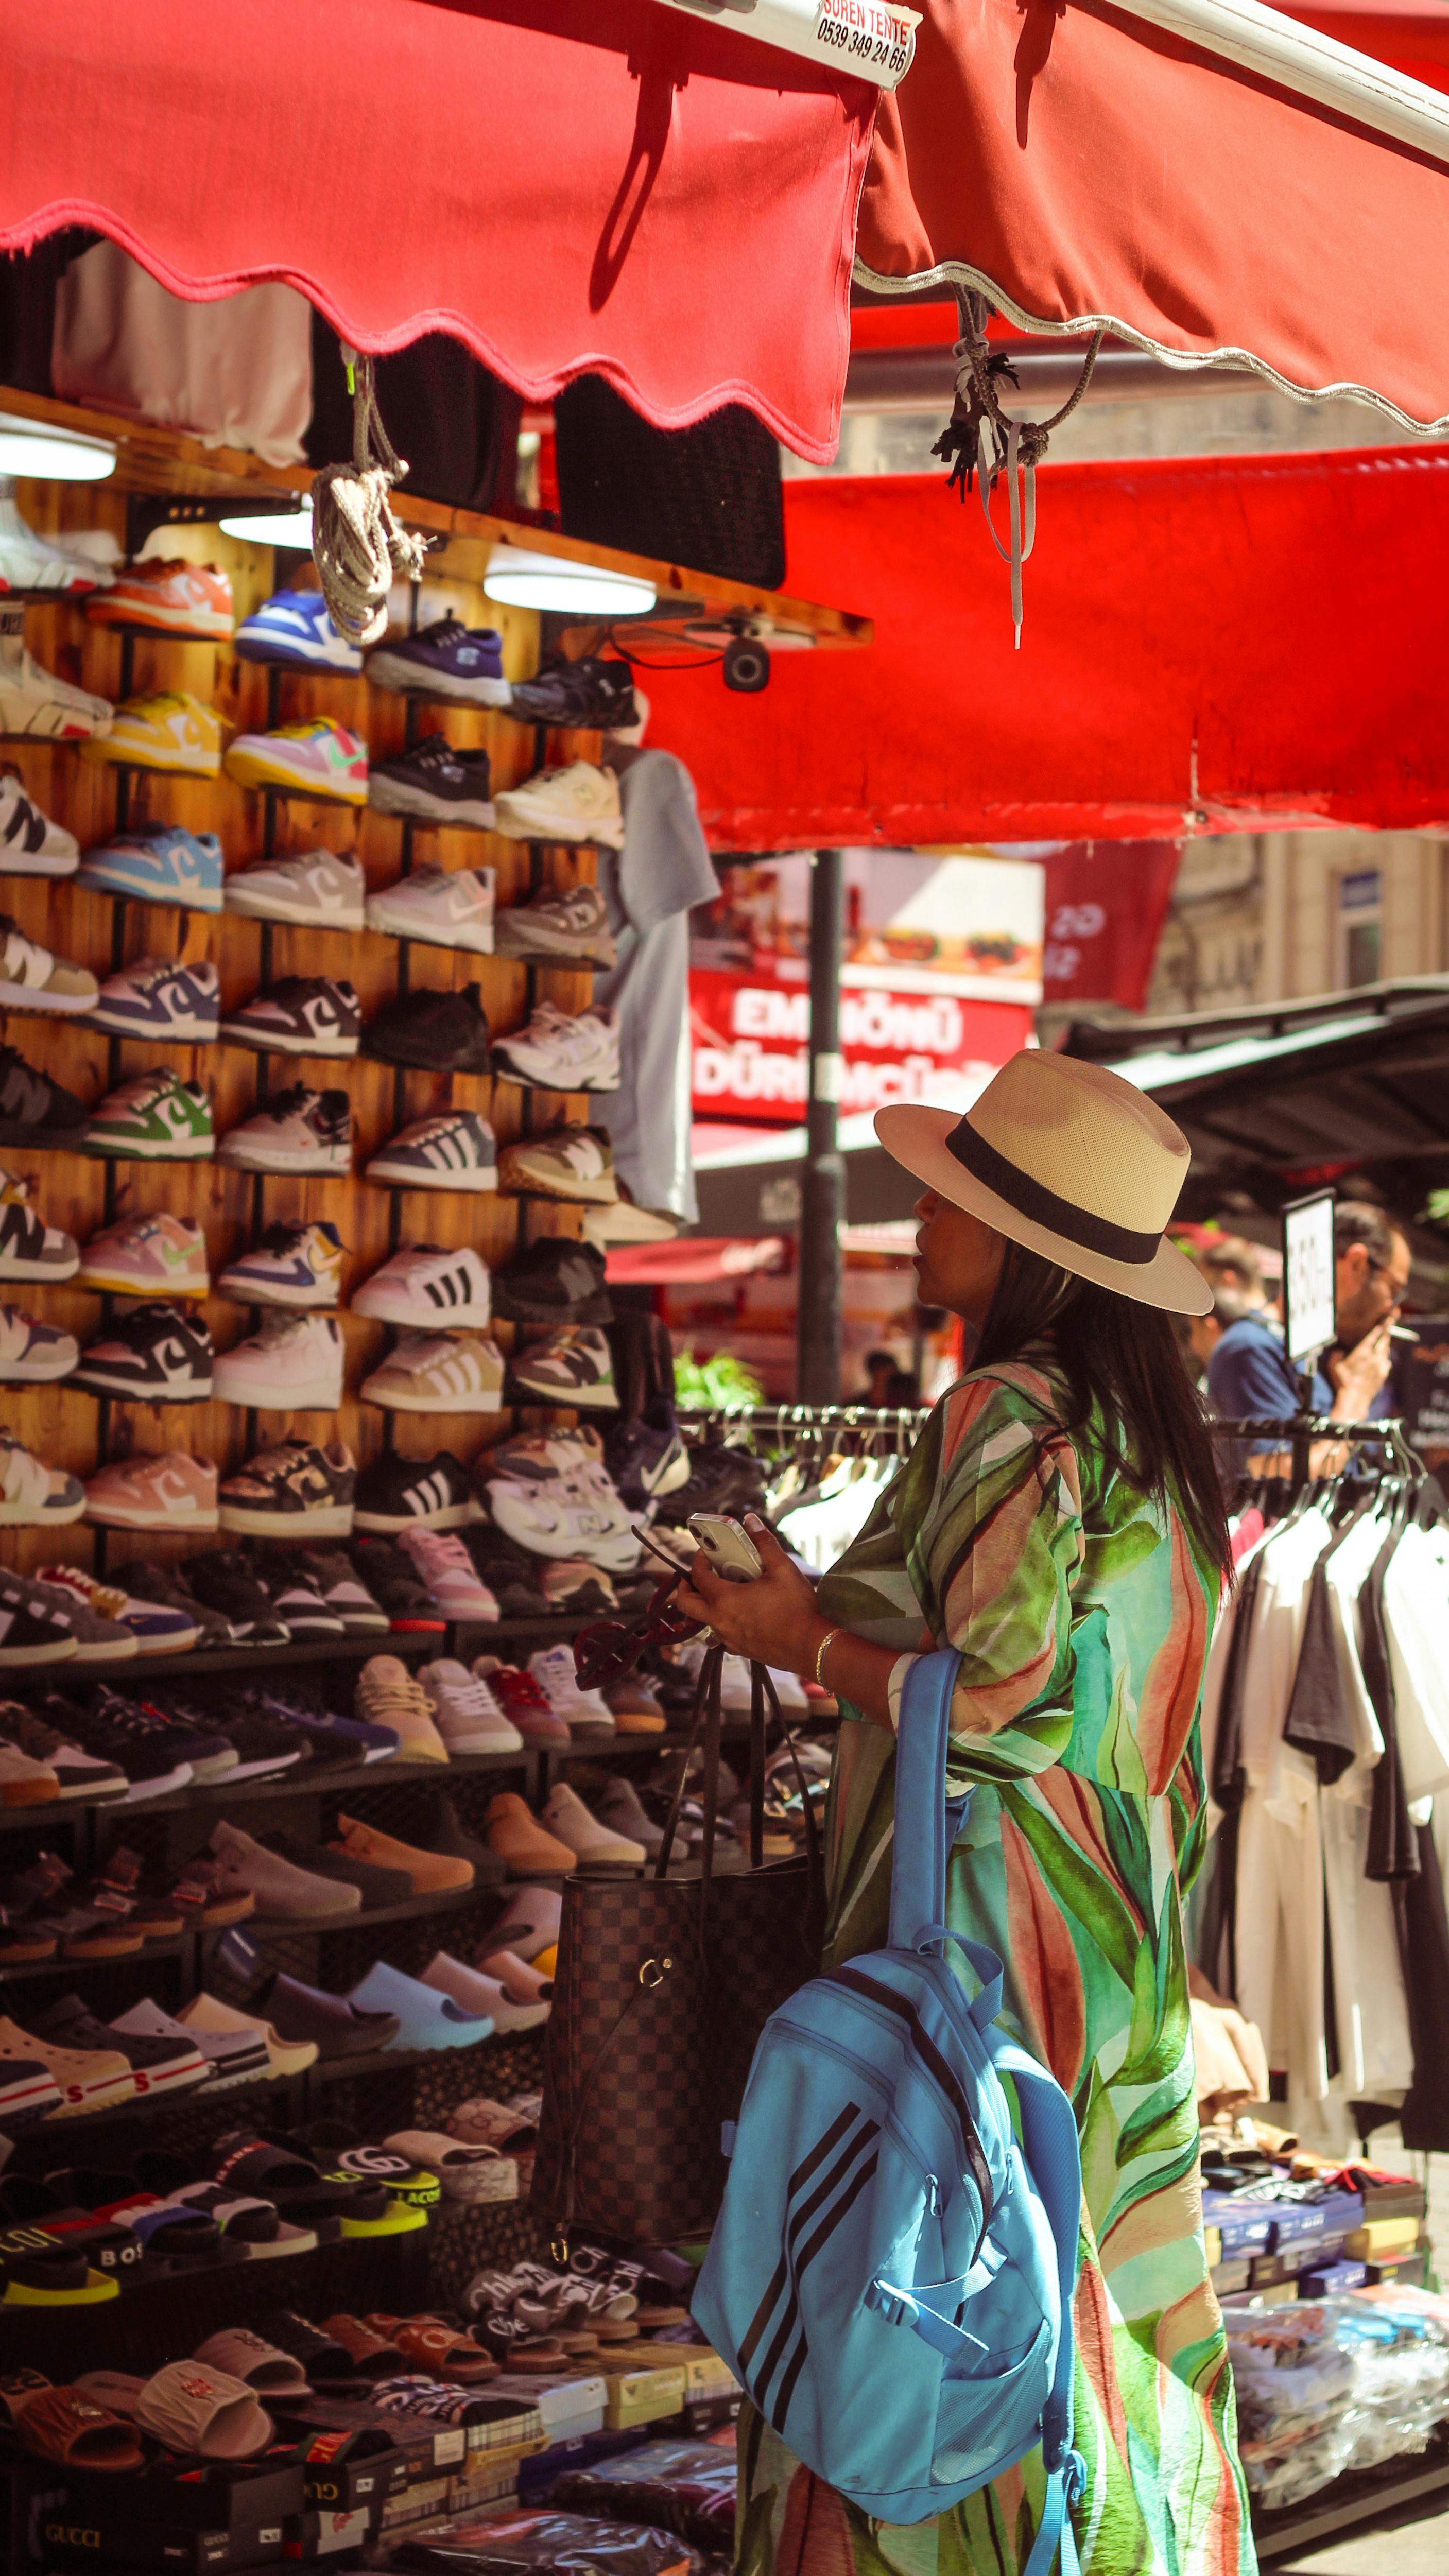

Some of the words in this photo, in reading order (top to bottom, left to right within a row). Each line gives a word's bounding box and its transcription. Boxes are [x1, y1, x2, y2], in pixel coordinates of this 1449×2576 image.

[817, 17, 849, 48] 0539
[848, 30, 872, 58] 349
[871, 40, 890, 65] 24
[889, 47, 906, 72] 66
[869, 8, 911, 46] TENTE
